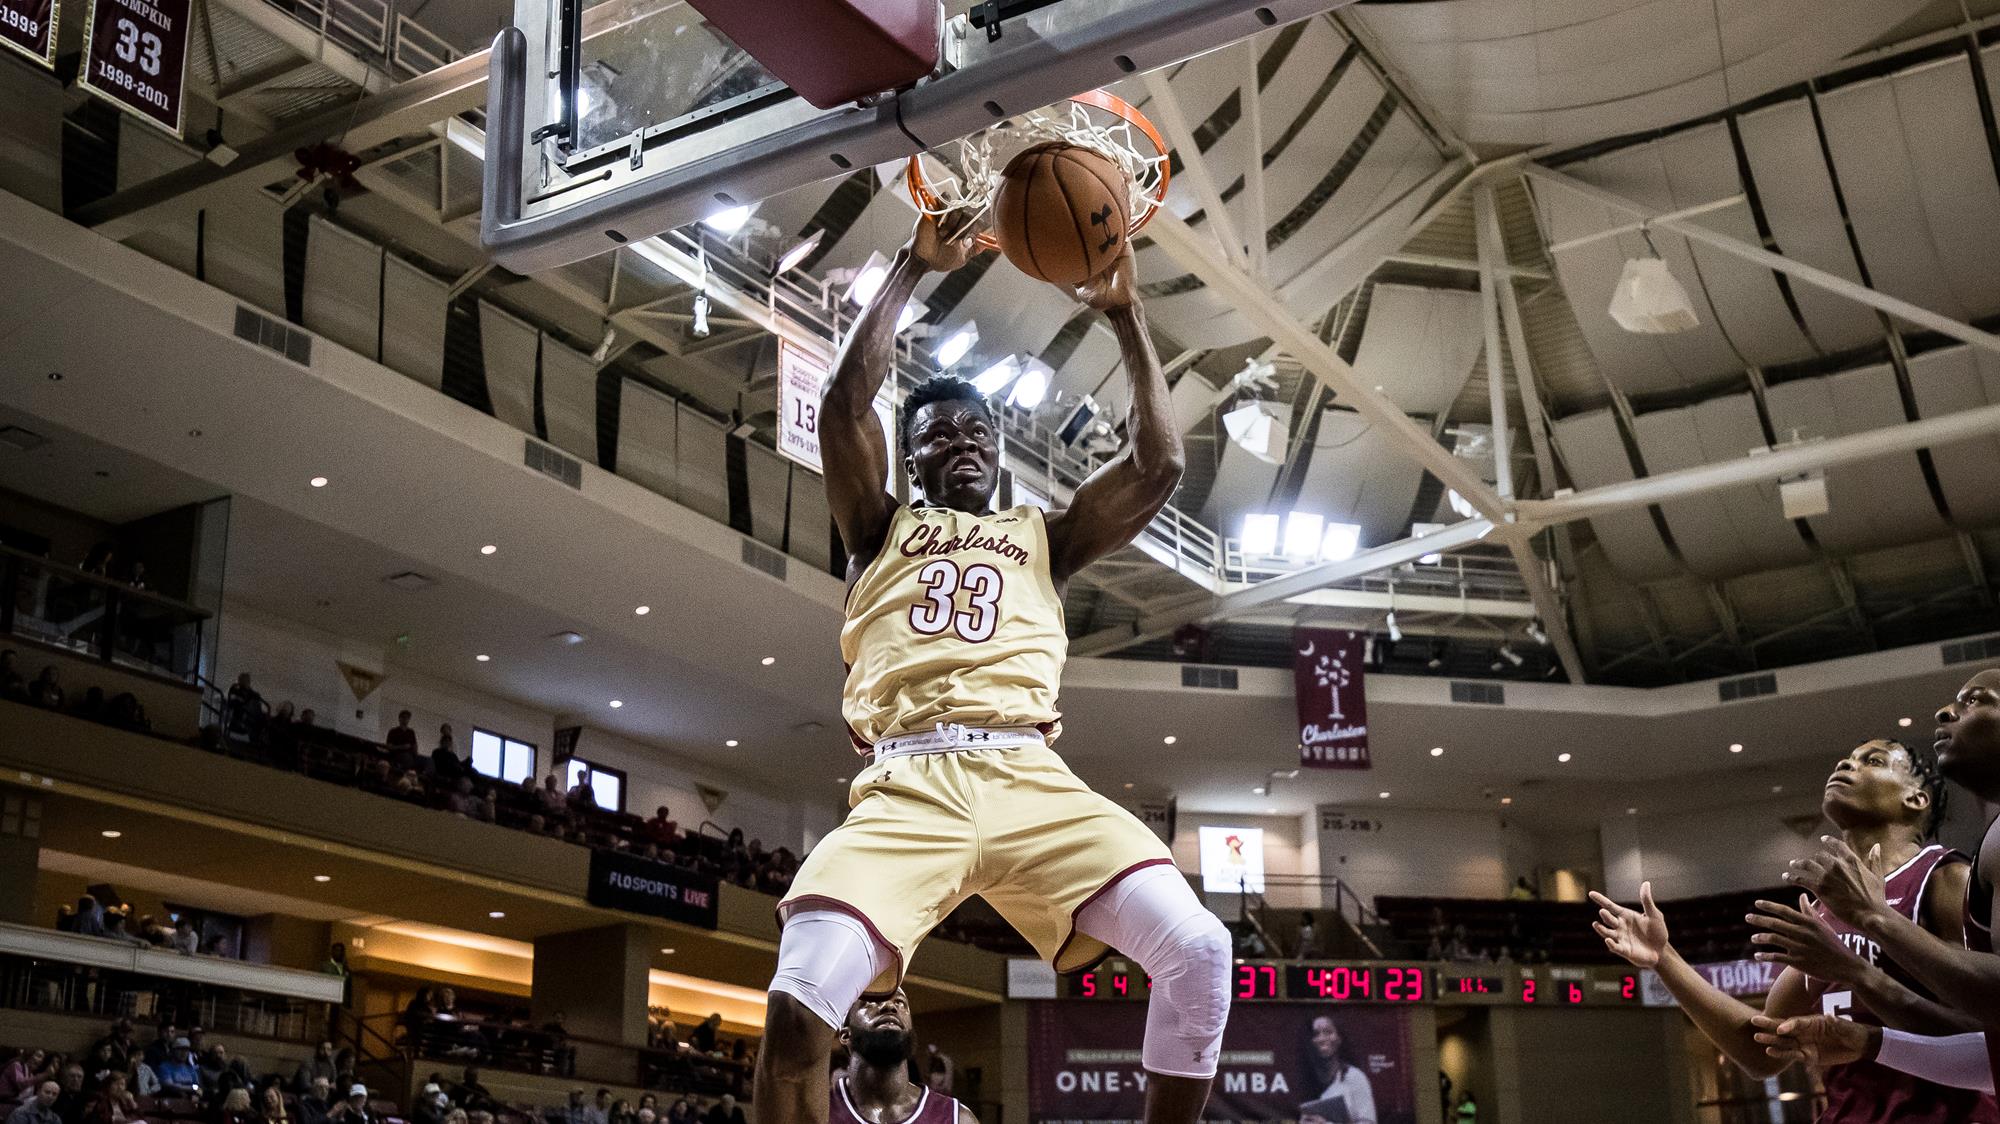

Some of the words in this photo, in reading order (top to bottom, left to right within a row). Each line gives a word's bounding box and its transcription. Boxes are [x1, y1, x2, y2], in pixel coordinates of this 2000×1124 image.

[115, 17, 162, 77] 33
[99, 60, 170, 111] 1998-2001
[794, 397, 816, 434] 13
[900, 523, 1029, 566] Charleston
[908, 558, 1004, 644] 33
[609, 871, 677, 900] FLOSPORTS
[684, 888, 708, 908] LIVE
[1082, 972, 1096, 998] 5
[1114, 975, 1127, 996] 4
[1238, 966, 1276, 998] 37
[1307, 967, 1370, 1000] 4:04
[1384, 968, 1422, 1000] 23
[1522, 980, 1536, 1003] 2
[1622, 976, 1635, 999] 2
[1056, 1070, 1148, 1093] ONE-Y
[1224, 1071, 1290, 1094] MBA
